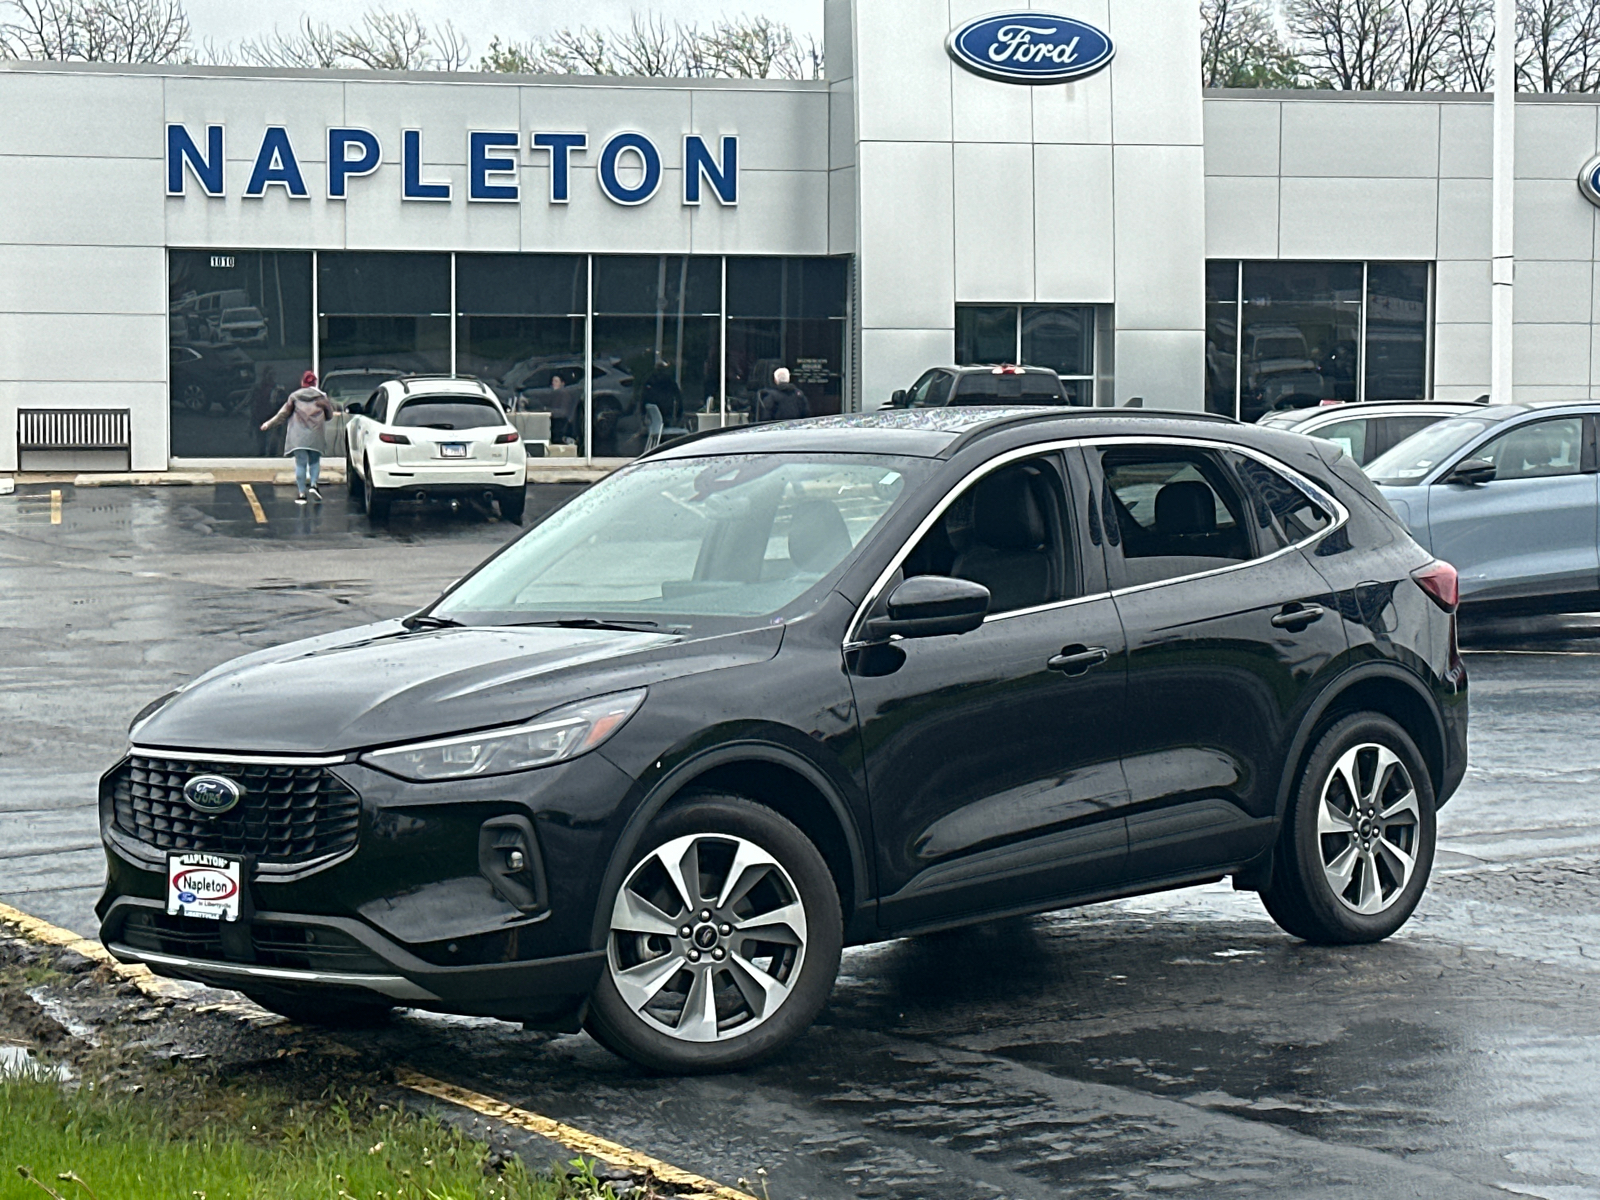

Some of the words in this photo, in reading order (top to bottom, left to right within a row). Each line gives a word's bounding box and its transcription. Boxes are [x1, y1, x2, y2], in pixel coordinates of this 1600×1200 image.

[988, 25, 1080, 64] Ford
[165, 123, 740, 206] NAPLETON
[193, 782, 225, 805] Ford
[183, 874, 227, 894] Napleton
